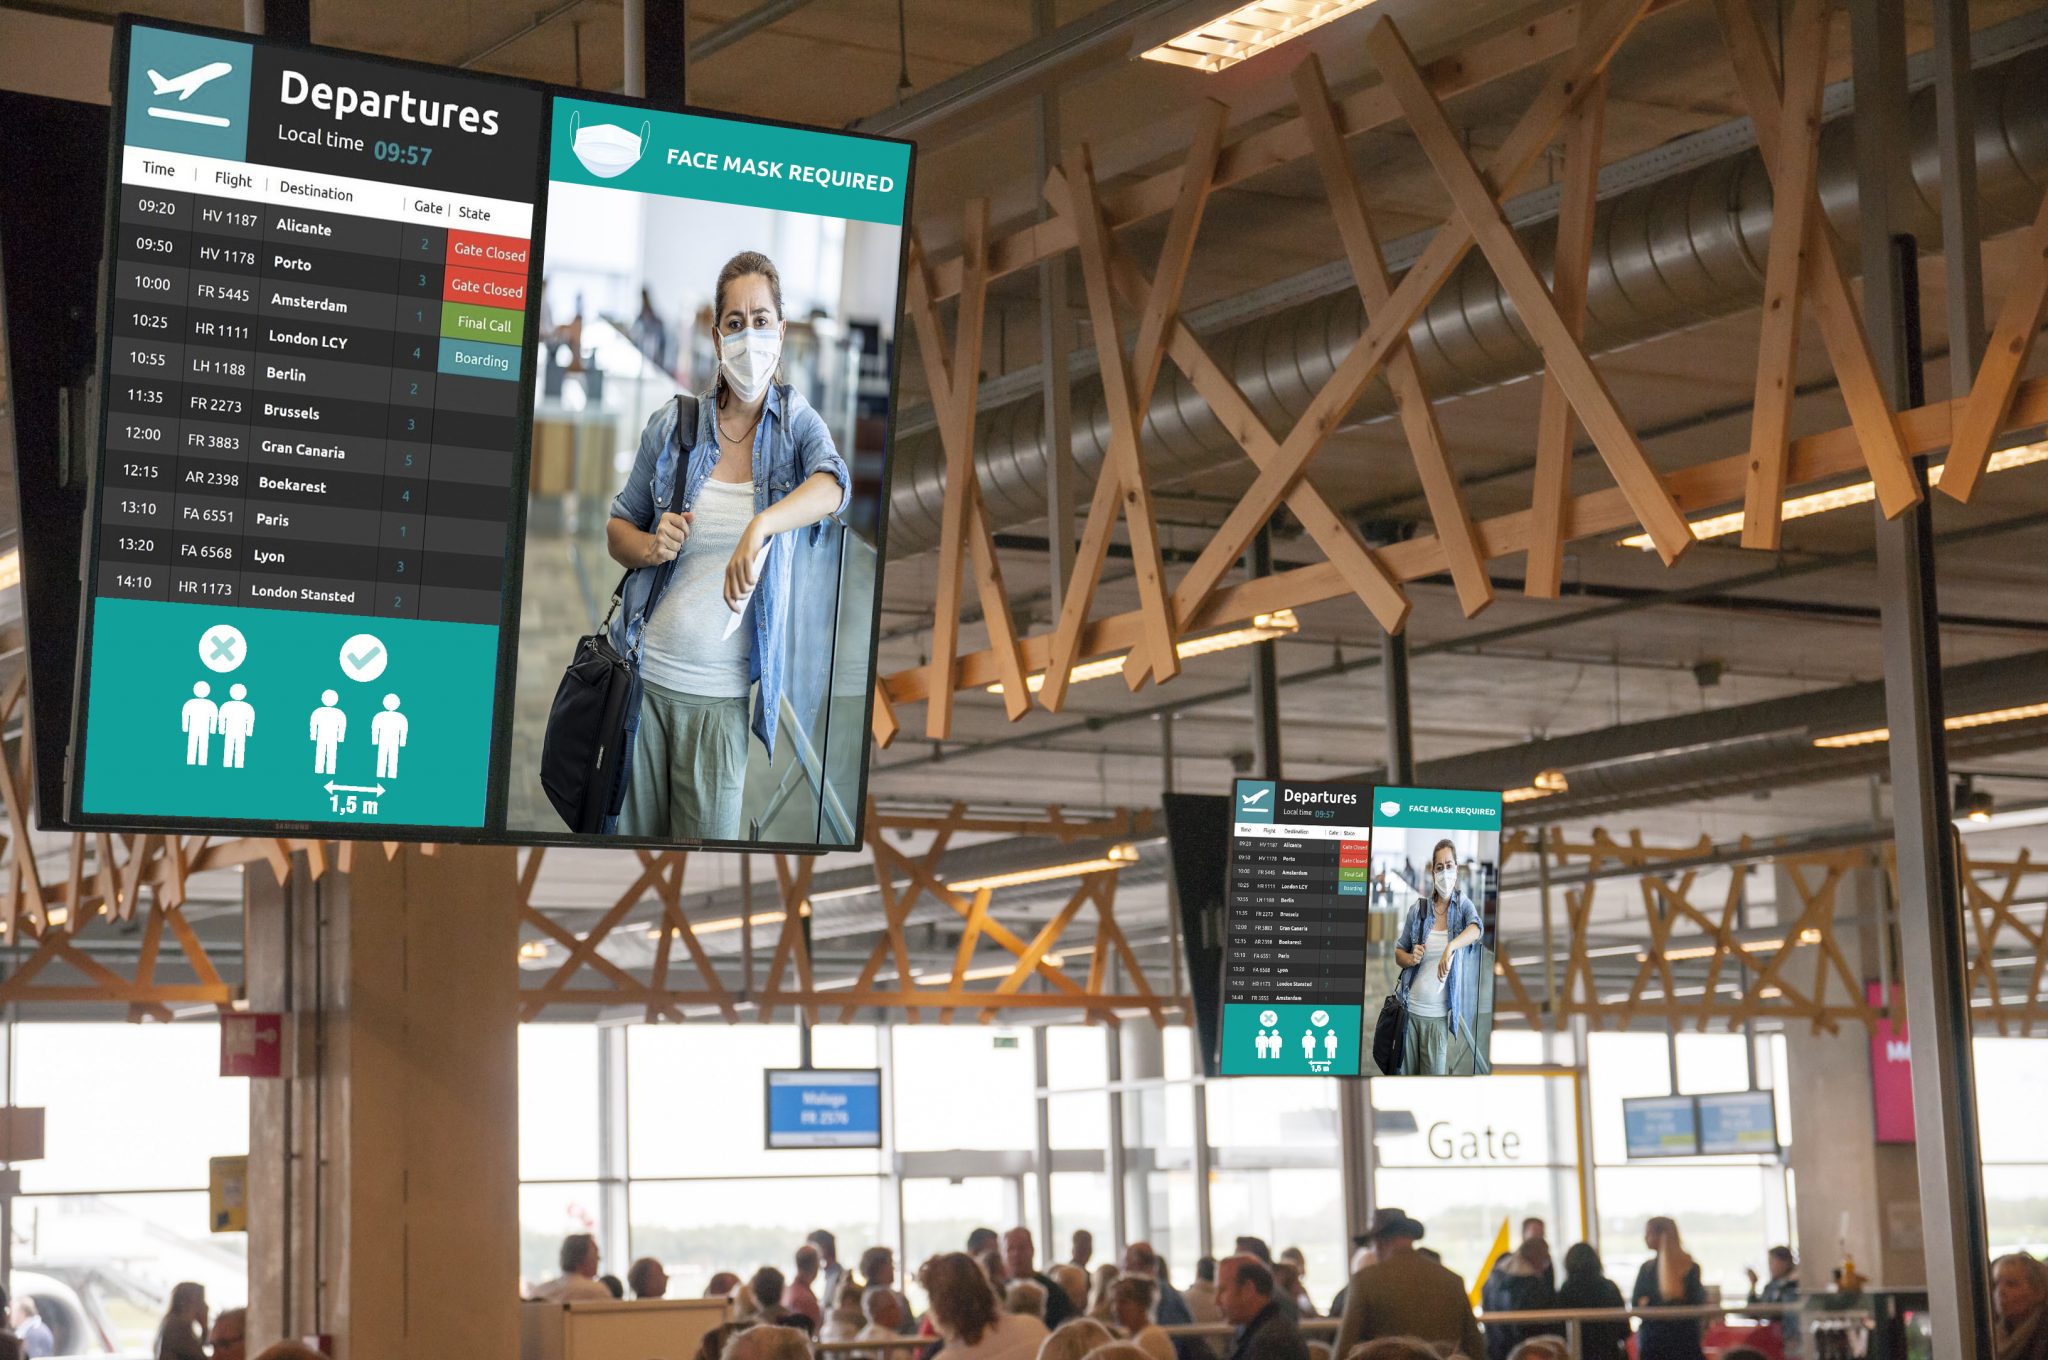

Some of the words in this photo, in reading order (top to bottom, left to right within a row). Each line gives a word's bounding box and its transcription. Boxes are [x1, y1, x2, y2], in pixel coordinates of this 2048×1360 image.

[280, 70, 499, 136] Departures
[278, 125, 321, 146] Local
[327, 131, 364, 151] time
[374, 140, 433, 166] 09:57
[666, 148, 718, 171] FACE
[723, 155, 783, 179] MASK
[788, 165, 894, 193] REQUIRED
[143, 160, 175, 177] Time
[215, 172, 253, 190] Flight
[280, 181, 353, 203] Destination
[414, 200, 443, 216] Gate
[459, 206, 491, 222] State
[138, 199, 176, 215] 09:20
[203, 209, 223, 223] HV
[226, 212, 257, 227] 1187
[277, 218, 332, 237] Alicante
[421, 238, 429, 250] 2
[455, 242, 483, 258] Gate
[486, 244, 526, 263] Closed
[136, 237, 173, 253] 09:50
[200, 247, 220, 261] HV
[224, 250, 255, 265] 1178
[274, 256, 312, 272] Porto
[418, 275, 426, 286] 3
[451, 278, 480, 295] Gate
[483, 282, 523, 300] Closed
[135, 276, 171, 291] 10:00
[198, 285, 215, 298] FR
[218, 287, 250, 302] 5445
[271, 293, 348, 315] Amsterdam
[416, 311, 422, 322] 1
[458, 316, 485, 332] Final
[488, 318, 512, 333] Call
[133, 314, 168, 329] 10:25
[195, 322, 214, 335] HR
[219, 325, 248, 339] 1111
[268, 330, 319, 348] London
[322, 337, 348, 351] LCY
[413, 347, 421, 359] 4
[455, 351, 509, 371] Boarding
[130, 352, 166, 366] 10:55
[193, 360, 210, 372] LH
[214, 362, 246, 376] 1188
[267, 366, 306, 382] Berlin
[410, 383, 417, 395] 2
[128, 389, 163, 404] 11:35
[191, 397, 207, 410] FR
[210, 399, 242, 413] 2273
[264, 404, 320, 420] Brussels
[407, 419, 415, 430] 3
[125, 426, 161, 441] 12:00
[188, 434, 205, 446] FR
[208, 436, 240, 450] 3883
[261, 441, 292, 454] Gran
[296, 444, 345, 459] Canaria
[405, 455, 413, 466] 5
[124, 464, 158, 478] 12:15
[185, 471, 204, 483] AR
[207, 473, 239, 487] 2398
[259, 477, 326, 494] Boekarest
[402, 491, 410, 502] 4
[121, 501, 156, 515] 13:10
[183, 508, 200, 520] FA
[203, 510, 234, 523] 6551
[256, 513, 289, 527] Paris
[400, 526, 406, 537] 1
[119, 538, 154, 551] 13:20
[181, 545, 197, 557] FA
[200, 547, 232, 559] 6568
[254, 550, 285, 564] Lyon
[397, 561, 404, 572] 3
[117, 575, 152, 589] 14:10
[178, 581, 198, 593] HR
[202, 583, 232, 596] 1173
[252, 585, 298, 599] London
[301, 589, 355, 603] Stansted
[394, 597, 402, 607] 2
[329, 795, 357, 816] 1,5
[363, 801, 378, 815] m
[1284, 789, 1357, 805] Departures
[1315, 810, 1335, 818] 09:57
[1430, 806, 1454, 814] MASK
[1456, 807, 1496, 816] REQUIRED
[1428, 1121, 1520, 1159] Gate
